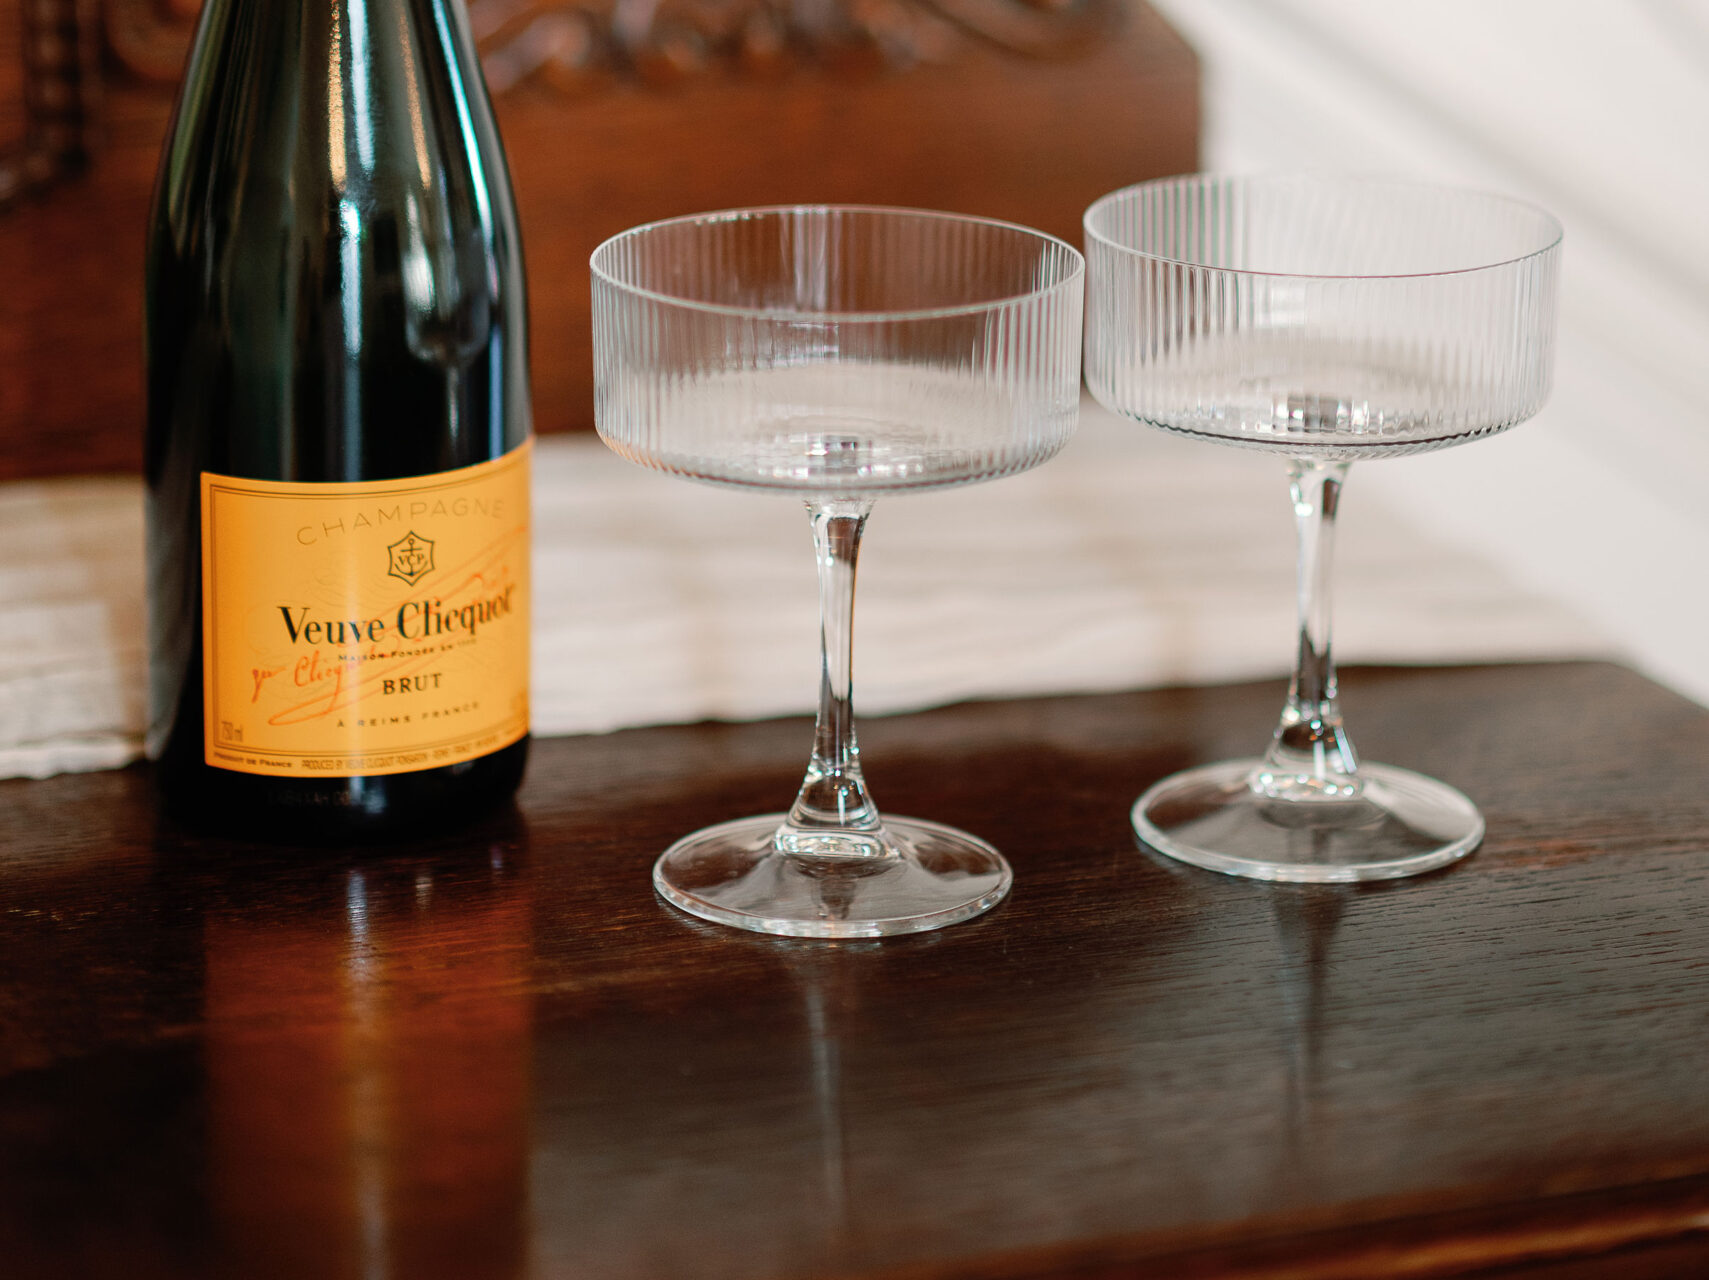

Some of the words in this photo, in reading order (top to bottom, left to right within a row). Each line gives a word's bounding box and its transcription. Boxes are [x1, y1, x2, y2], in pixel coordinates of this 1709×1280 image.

[296, 497, 505, 546] CHAMPAGNE
[398, 553, 425, 567] VCP
[276, 606, 385, 645] Veuve
[397, 582, 516, 640] Clicquot
[382, 672, 443, 695] BRUT
[357, 715, 411, 727] REIMS
[421, 701, 479, 719] FRANCE
[259, 758, 293, 768] FRANCE
